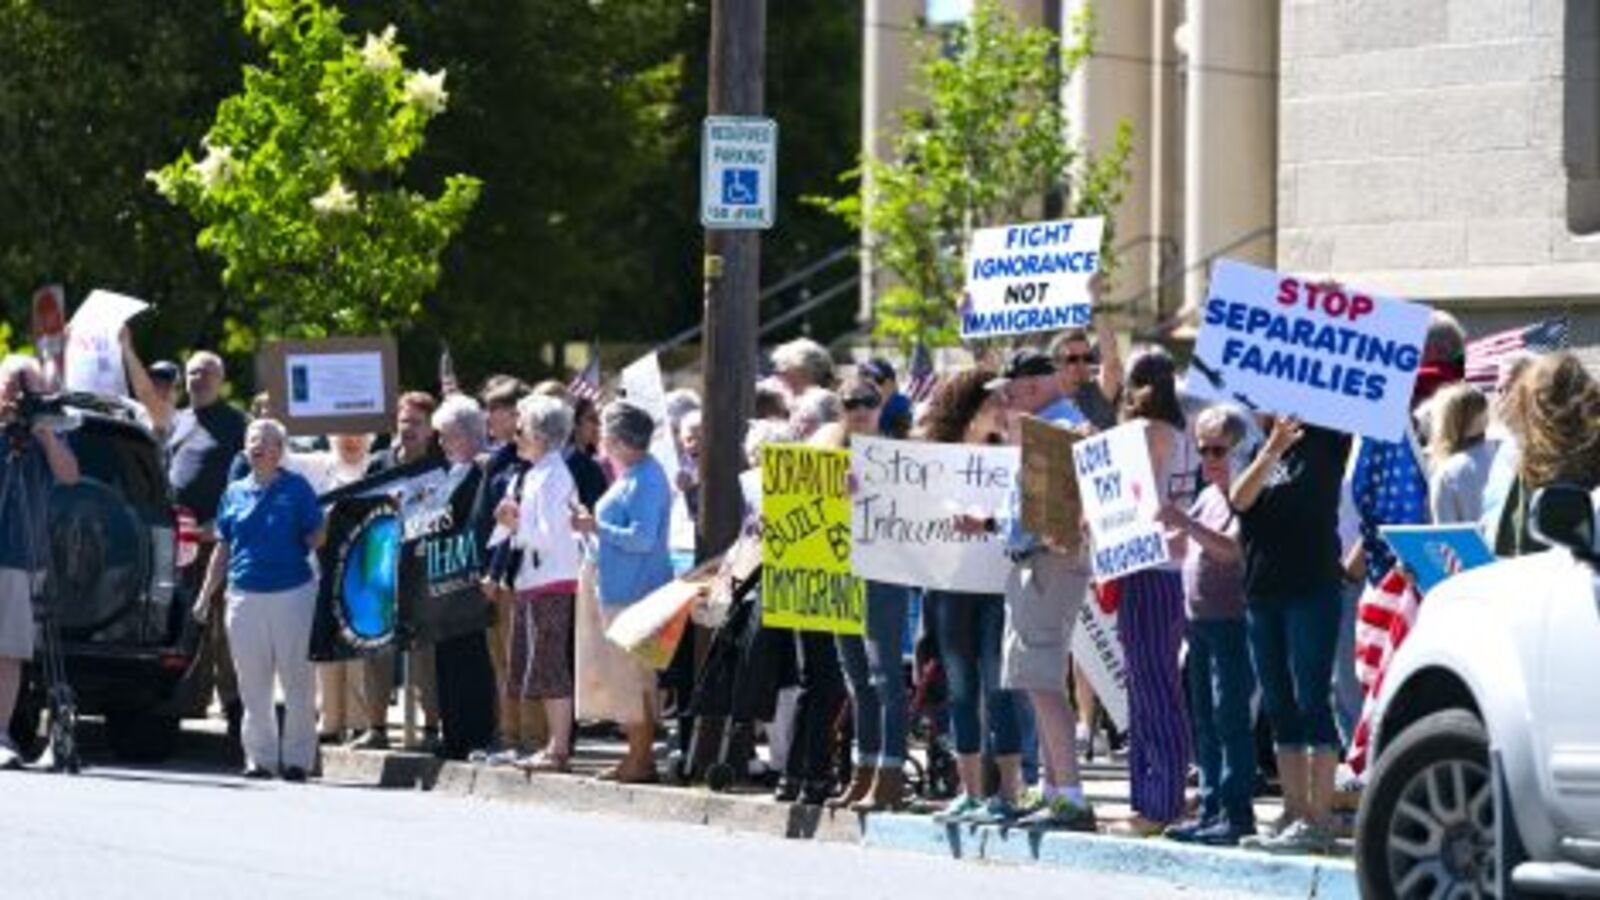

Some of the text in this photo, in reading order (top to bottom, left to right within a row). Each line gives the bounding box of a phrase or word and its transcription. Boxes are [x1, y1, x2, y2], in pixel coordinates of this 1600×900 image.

[714, 145, 766, 164] PARKING
[1005, 223, 1073, 248] FIGHT
[972, 251, 1098, 280] IGNORANCE
[1004, 282, 1049, 304] NOT
[1277, 278, 1374, 321] STOP
[963, 303, 1091, 334] IMMIGRANTS
[1205, 299, 1419, 372] SEPARATING
[1221, 339, 1388, 401] FAMILIES
[864, 445, 1009, 491] Stop the
